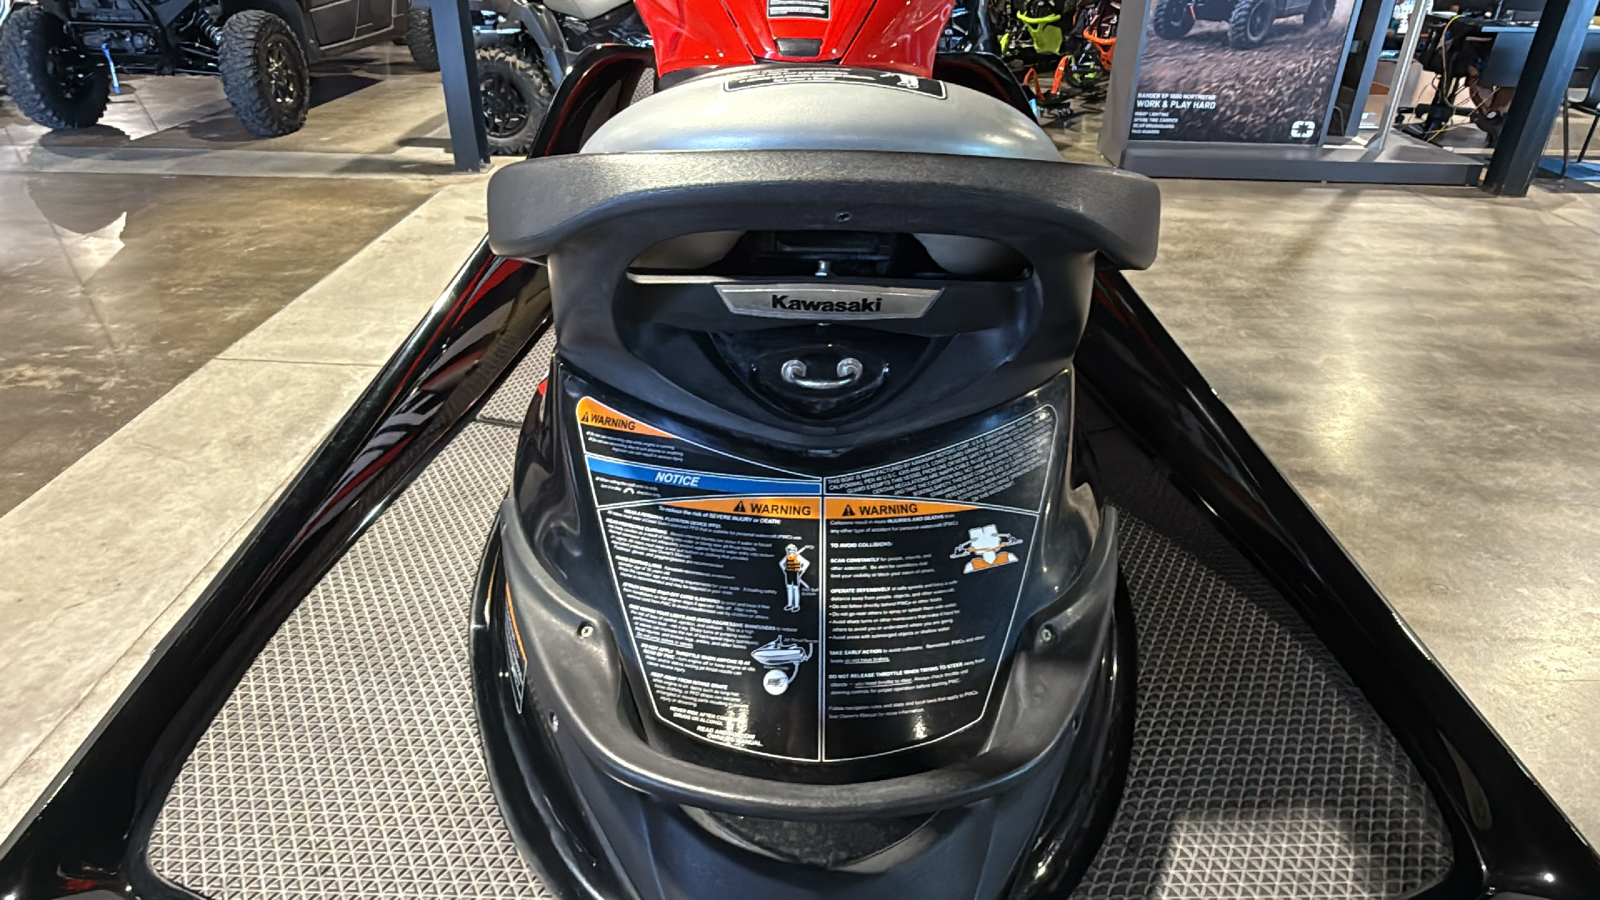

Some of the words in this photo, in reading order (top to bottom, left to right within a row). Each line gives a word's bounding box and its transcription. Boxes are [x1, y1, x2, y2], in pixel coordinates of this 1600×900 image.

[772, 295, 881, 312] Kawasaki
[591, 414, 635, 430] WARNING
[655, 472, 700, 487] NOTICE
[750, 503, 811, 515] WARNING
[859, 504, 917, 515] WARNING
[697, 725, 713, 733] READ
